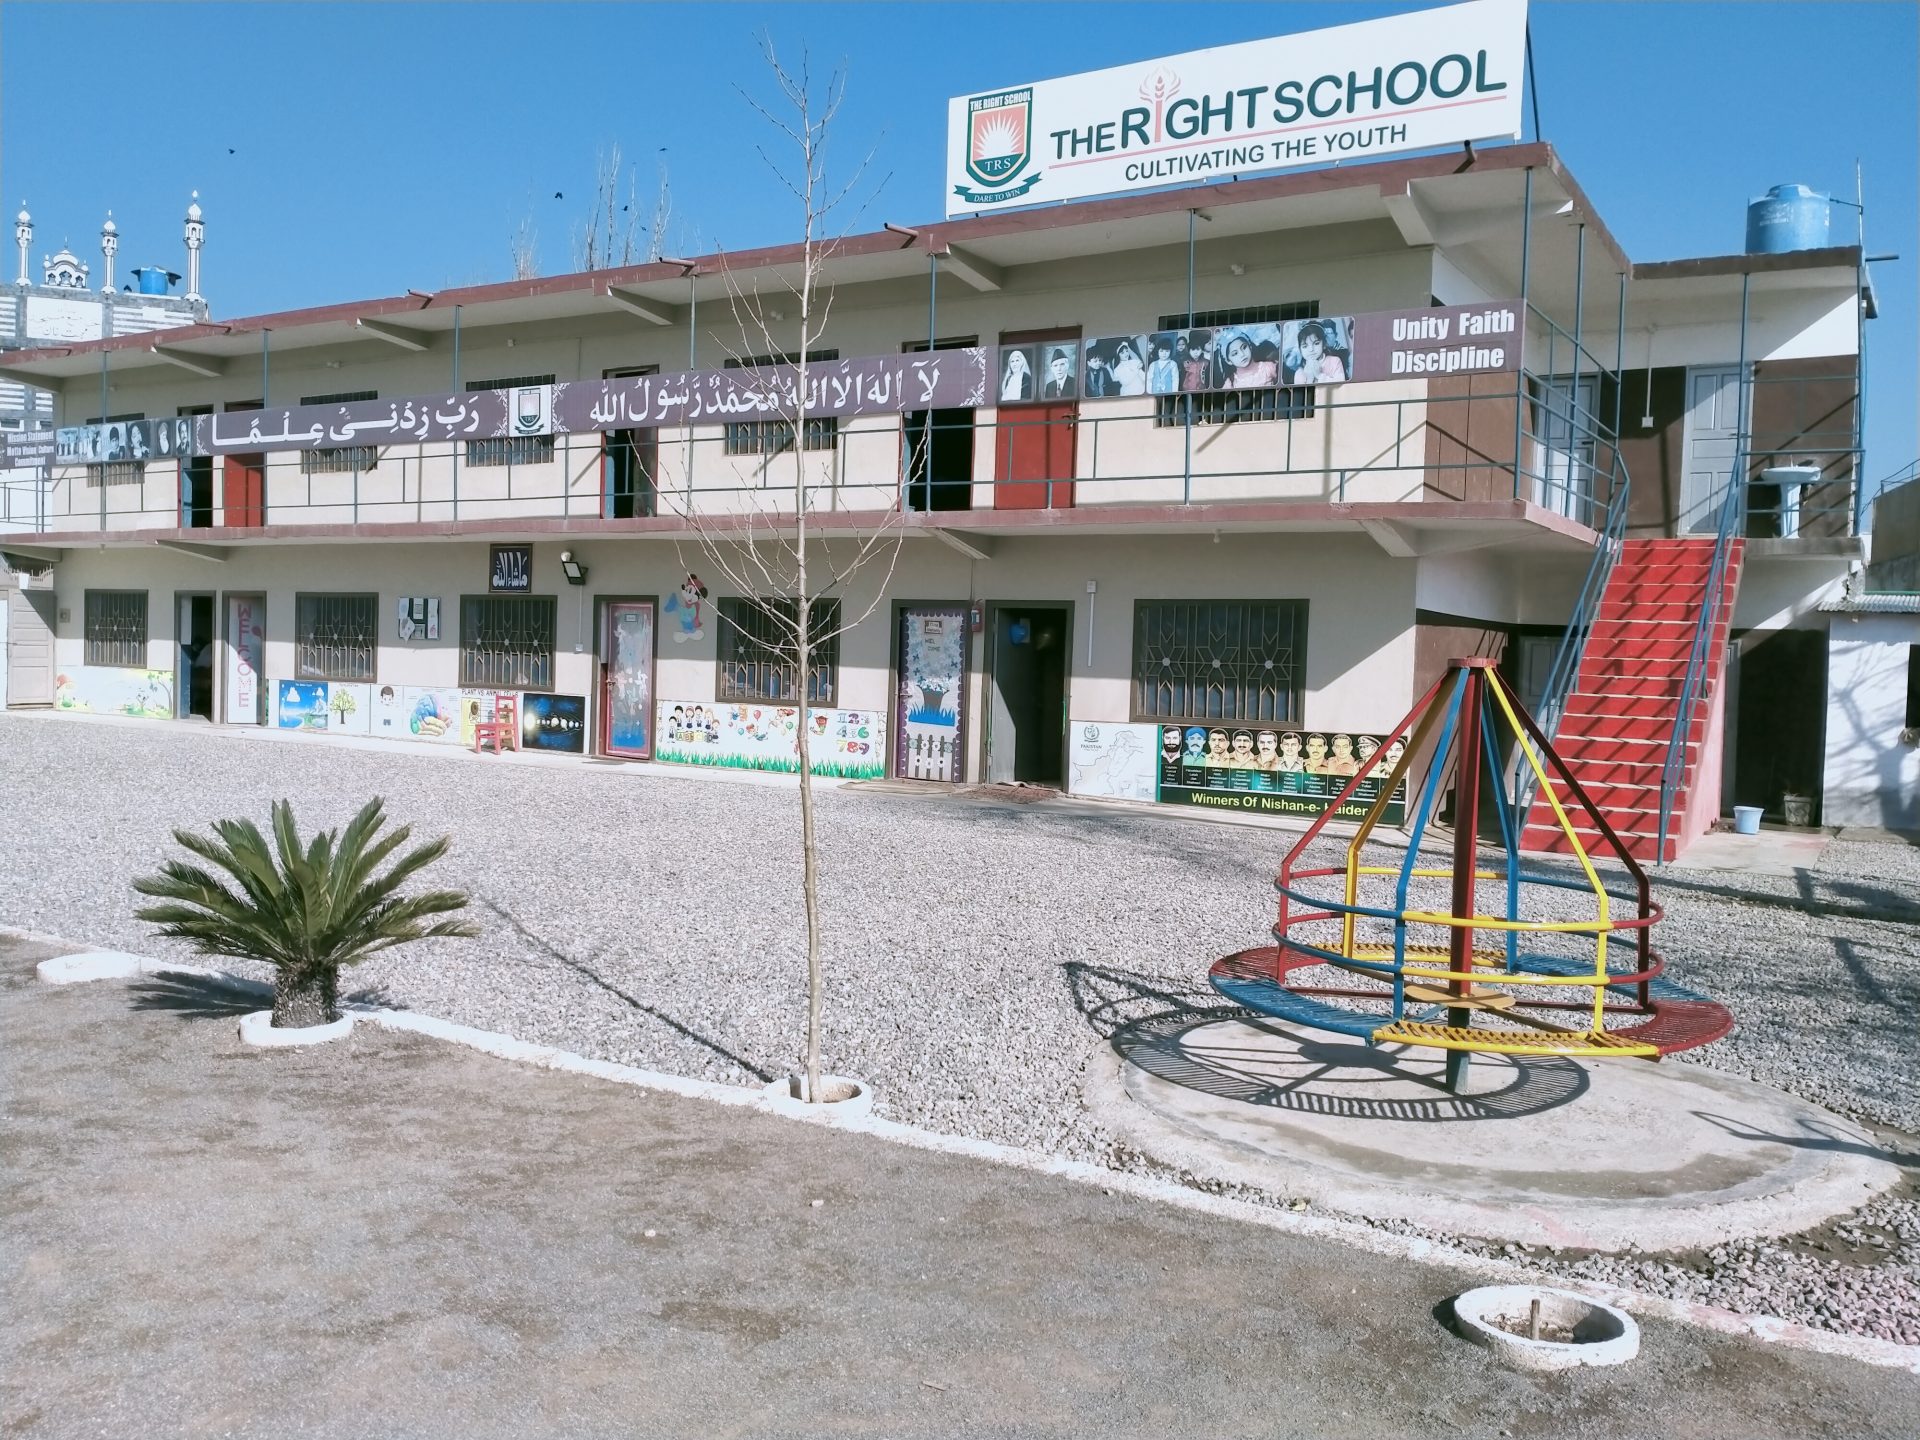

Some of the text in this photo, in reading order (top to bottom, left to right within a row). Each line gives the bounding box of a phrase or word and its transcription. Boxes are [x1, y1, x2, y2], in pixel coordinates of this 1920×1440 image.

[970, 90, 1031, 112] THE RIGHT SCHOOL
[1050, 122, 1116, 160] THE
[1273, 49, 1508, 124] SCHOOL
[985, 157, 1012, 172] TRS
[1125, 123, 1407, 182] CULTIVATING THE YOUTH
[974, 188, 1021, 202] DARE TO WIN
[1392, 309, 1515, 342] Unity Faith
[1391, 346, 1505, 374] Discipline
[237, 603, 253, 708] WELCOME
[1191, 792, 1240, 807] Winners
[1243, 796, 1257, 807] Of
[1325, 802, 1369, 816] aider
